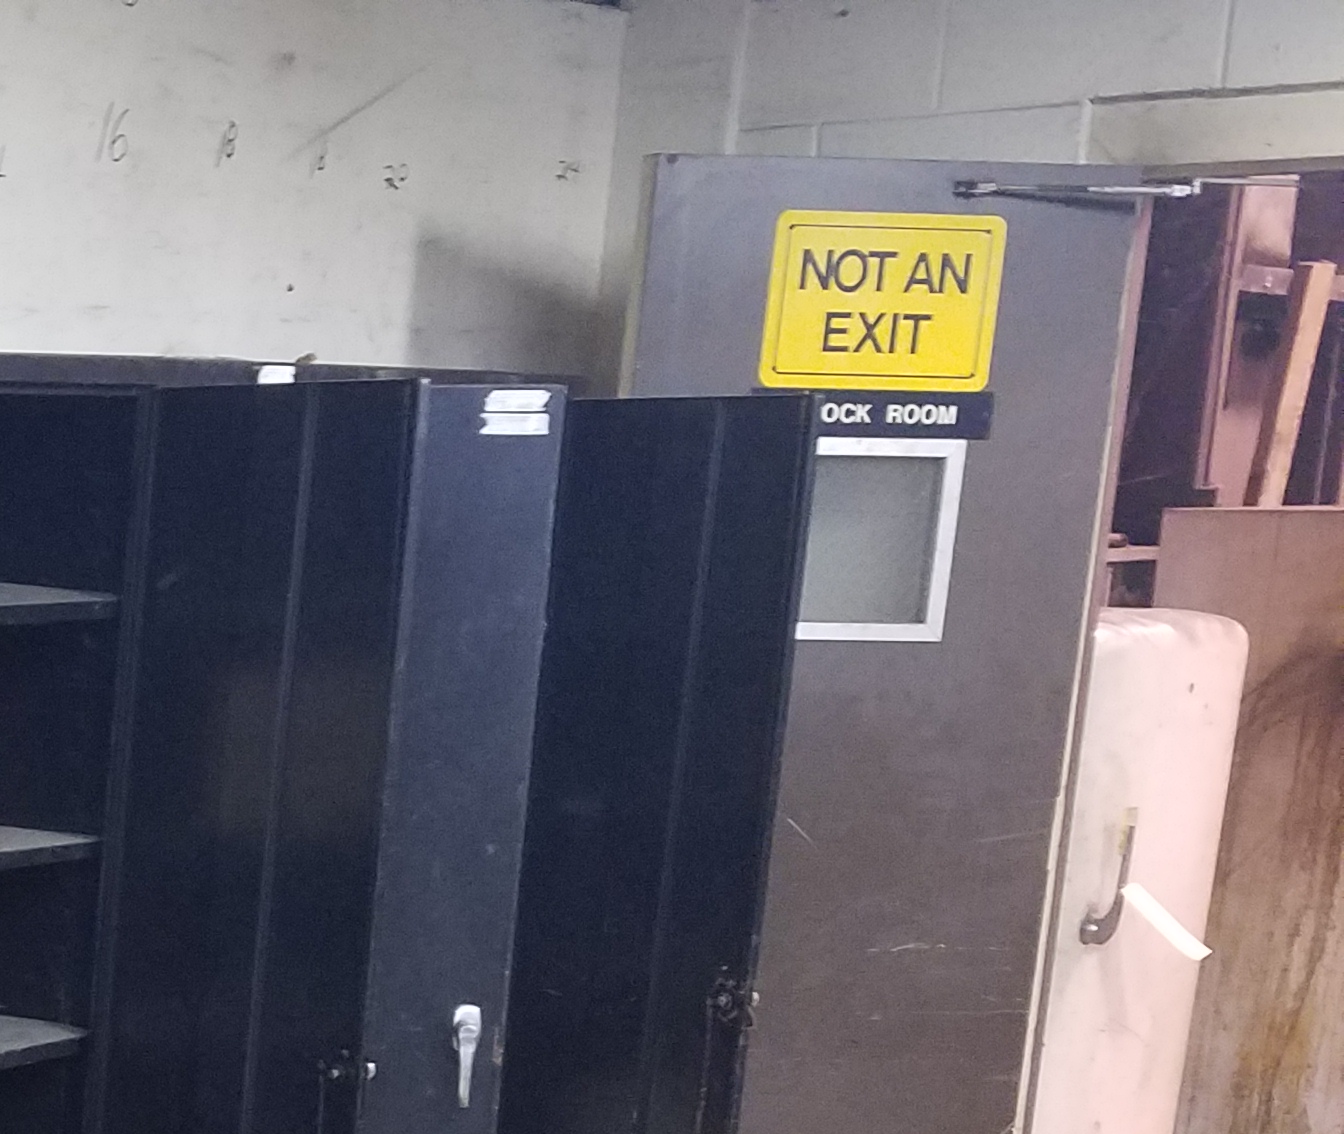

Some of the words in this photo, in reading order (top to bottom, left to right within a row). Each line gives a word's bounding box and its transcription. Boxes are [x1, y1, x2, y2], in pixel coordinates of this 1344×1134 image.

[95, 101, 131, 163] 16
[799, 248, 900, 293] NOT
[903, 251, 973, 294] AN
[822, 311, 934, 355] EXIT
[820, 402, 873, 424] OCK
[885, 403, 958, 425] ROOM
